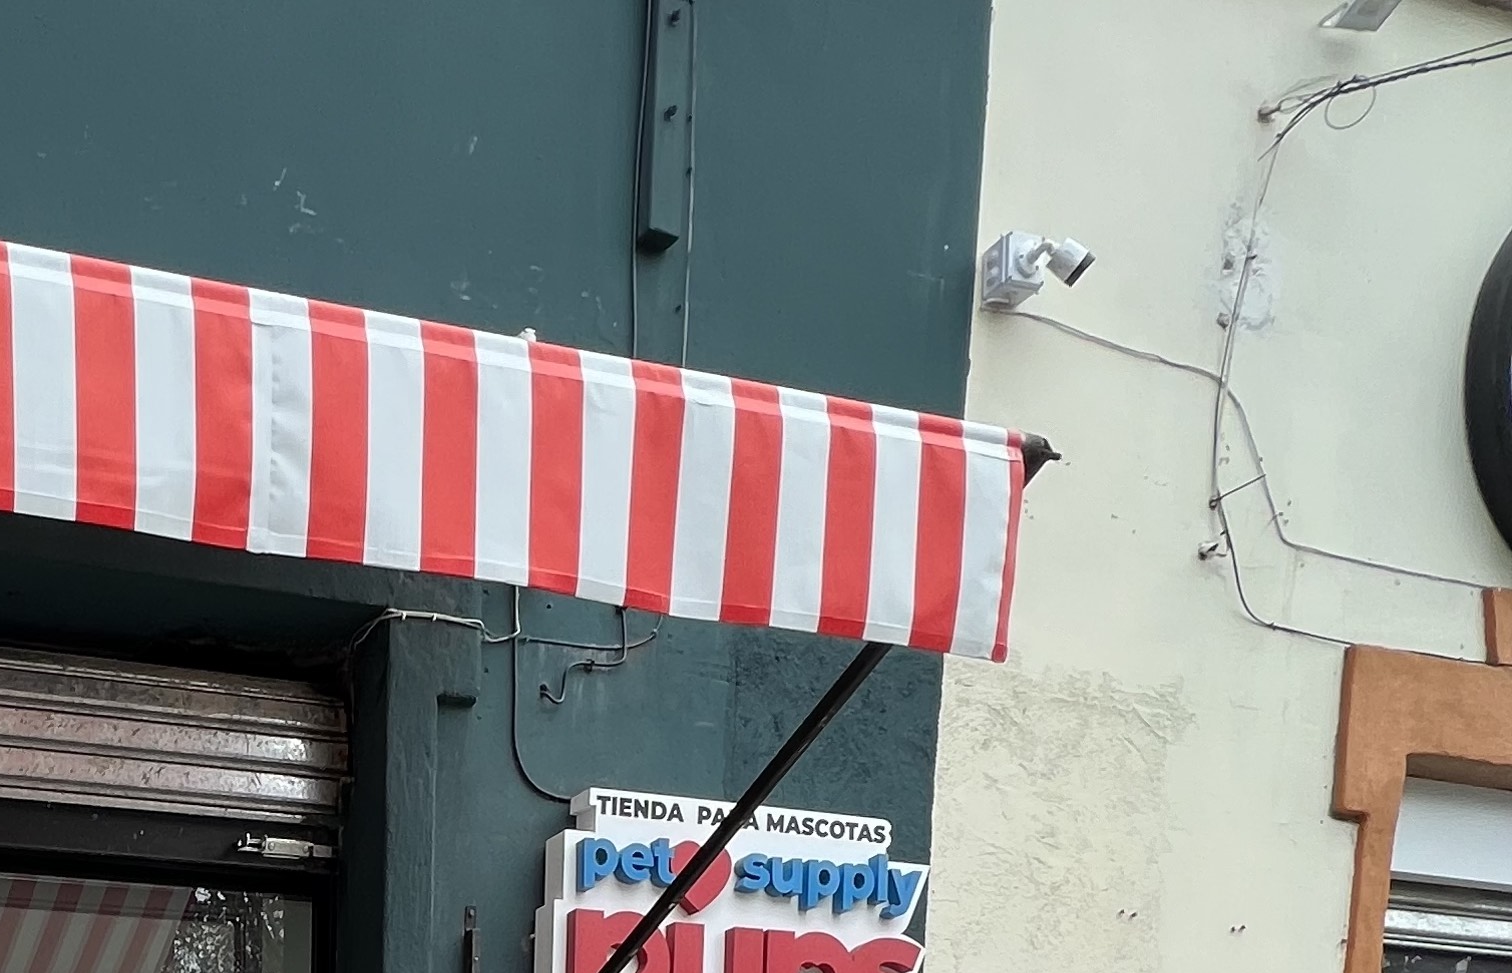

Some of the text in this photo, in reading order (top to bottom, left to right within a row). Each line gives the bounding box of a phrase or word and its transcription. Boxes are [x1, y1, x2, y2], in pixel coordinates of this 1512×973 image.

[596, 795, 886, 844] TIENDA PAA MASCOTAS
[576, 836, 922, 920] pet supply
